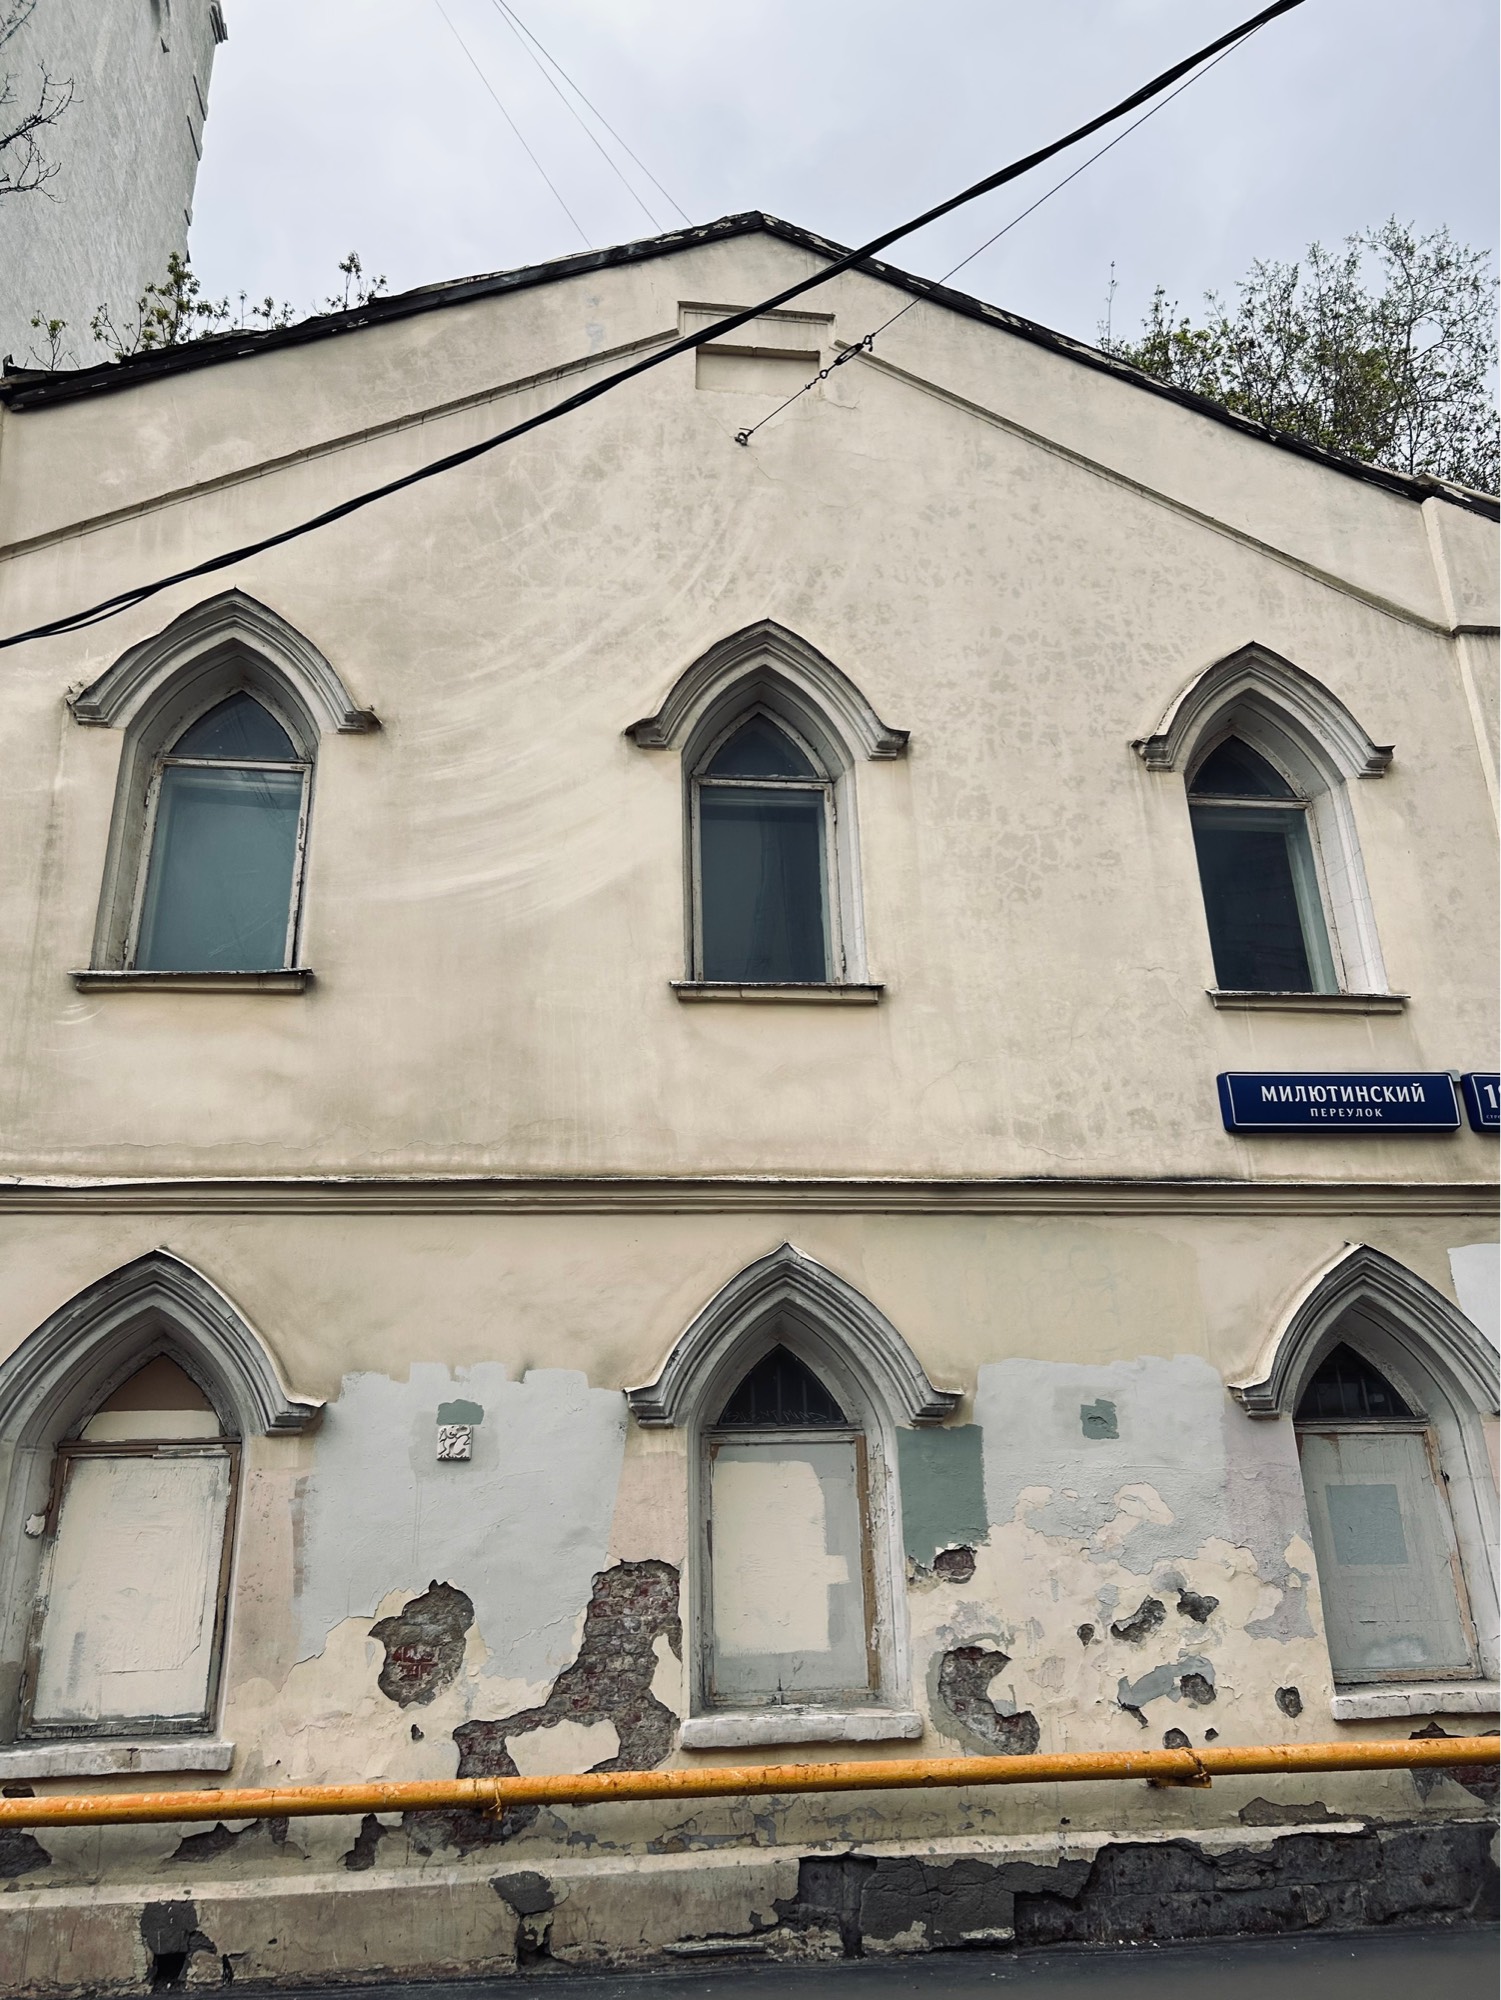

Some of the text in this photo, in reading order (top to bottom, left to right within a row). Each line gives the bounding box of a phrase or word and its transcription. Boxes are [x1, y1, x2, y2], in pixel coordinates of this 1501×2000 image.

[1260, 1083, 1426, 1103] МИЛЮТИНСКИЙ
[1483, 1084, 1500, 1109] 1
[1310, 1108, 1383, 1118] ПЕРЕУЛОК
